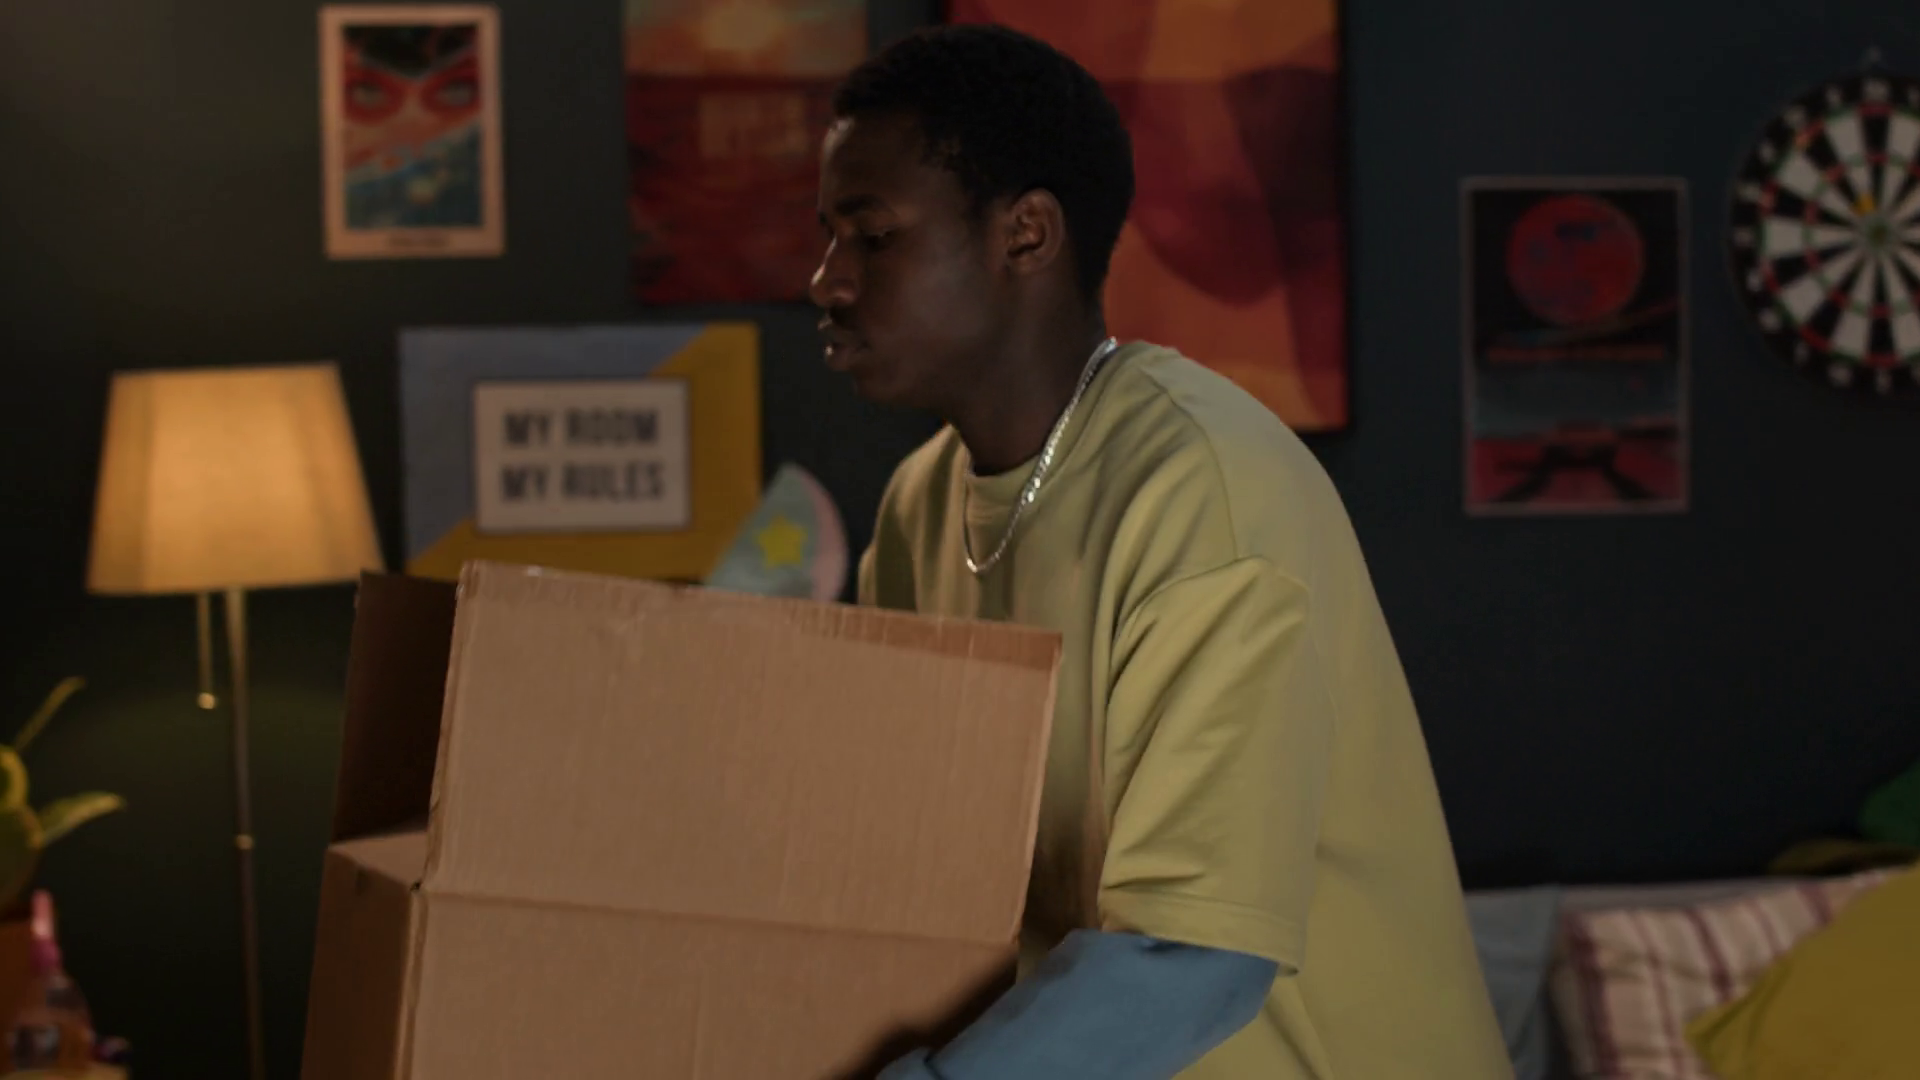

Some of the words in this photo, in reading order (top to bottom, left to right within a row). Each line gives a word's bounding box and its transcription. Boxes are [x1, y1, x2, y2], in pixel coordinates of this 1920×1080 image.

[504, 411, 549, 446] MY
[565, 409, 658, 445] ROOM
[502, 465, 548, 500] MY
[562, 461, 664, 500] RULES
